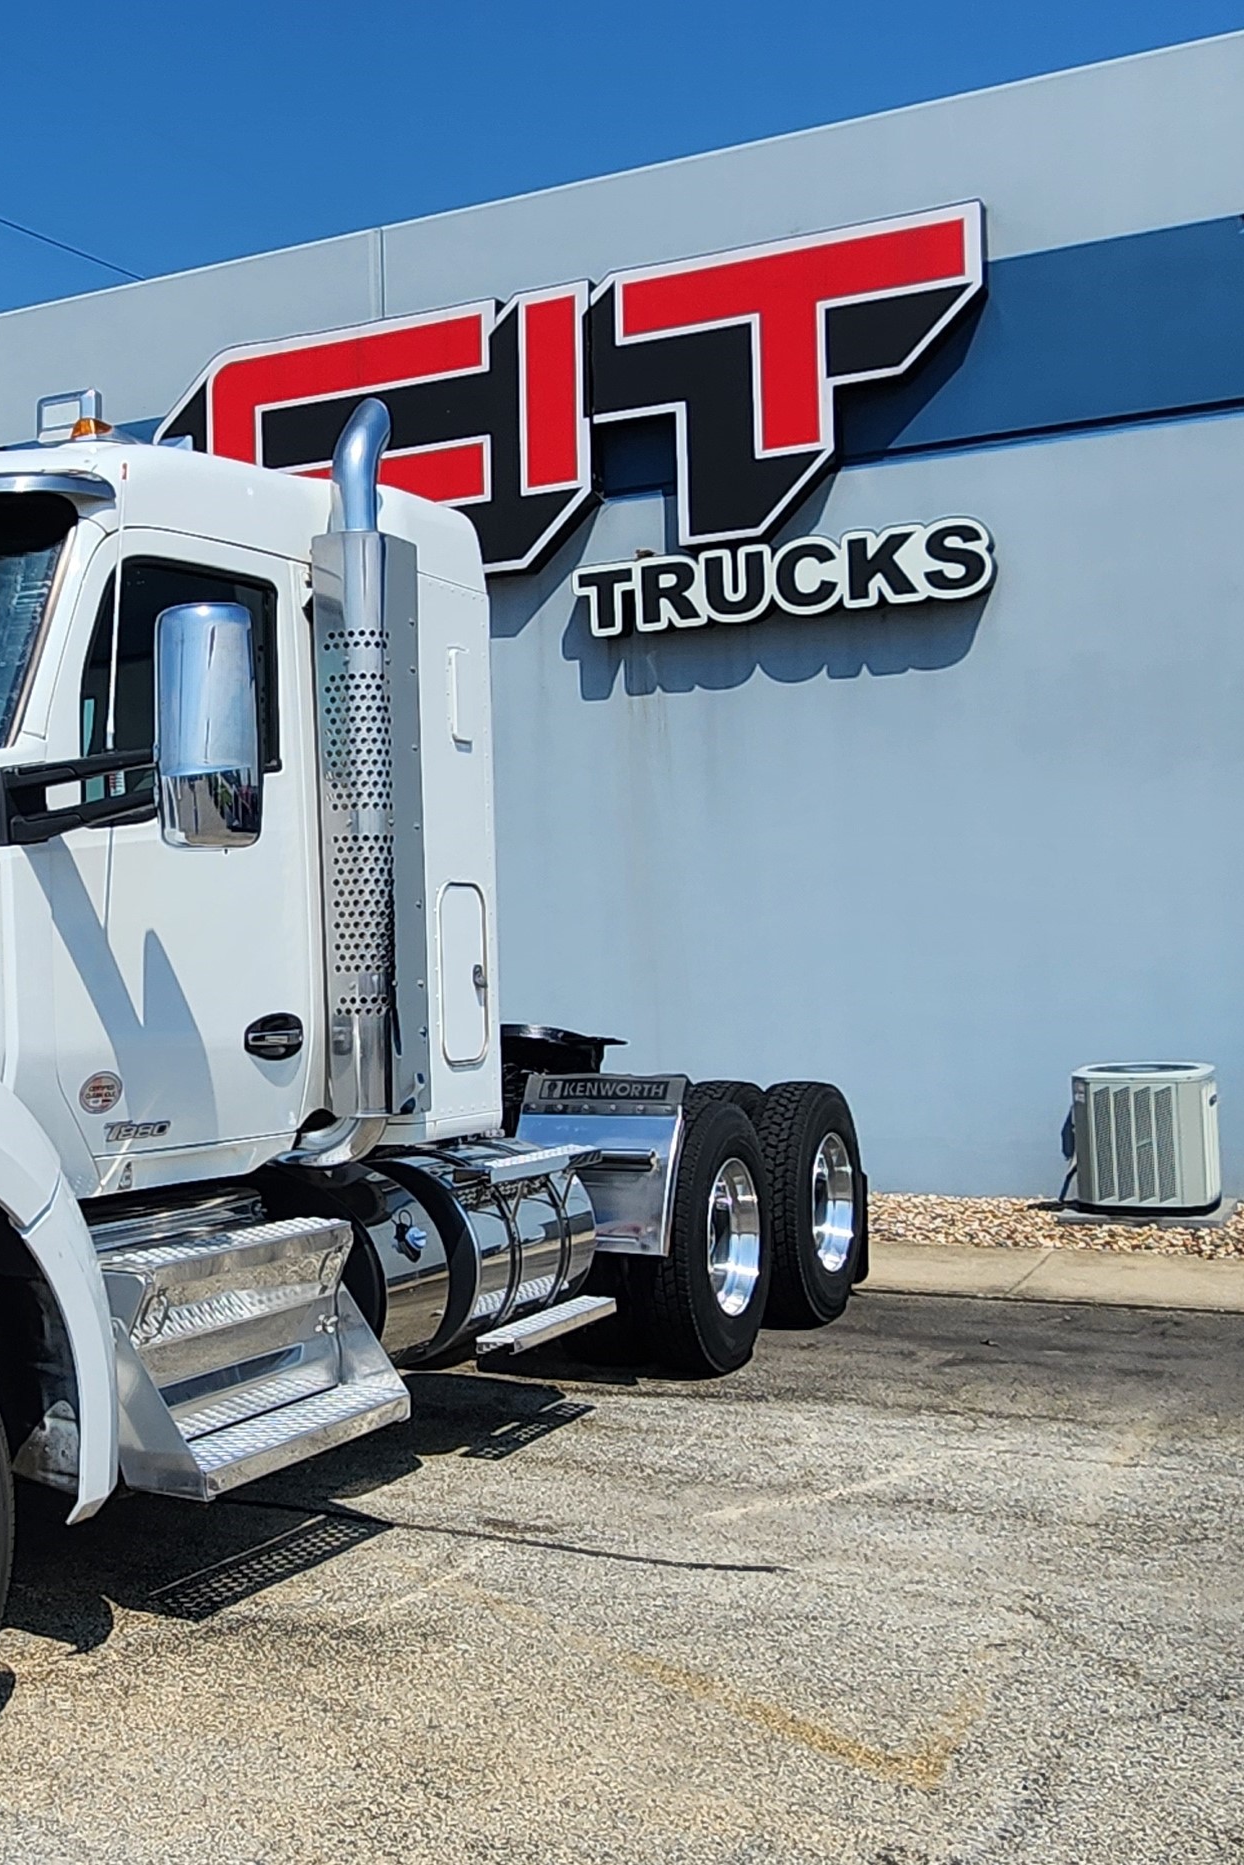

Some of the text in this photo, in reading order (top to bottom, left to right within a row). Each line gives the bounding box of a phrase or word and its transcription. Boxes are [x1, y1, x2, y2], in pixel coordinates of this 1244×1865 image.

[181, 203, 984, 545] CIT
[575, 521, 989, 633] TRUCKS
[562, 1081, 665, 1098] KENWORTH
[104, 1120, 171, 1142] T880
